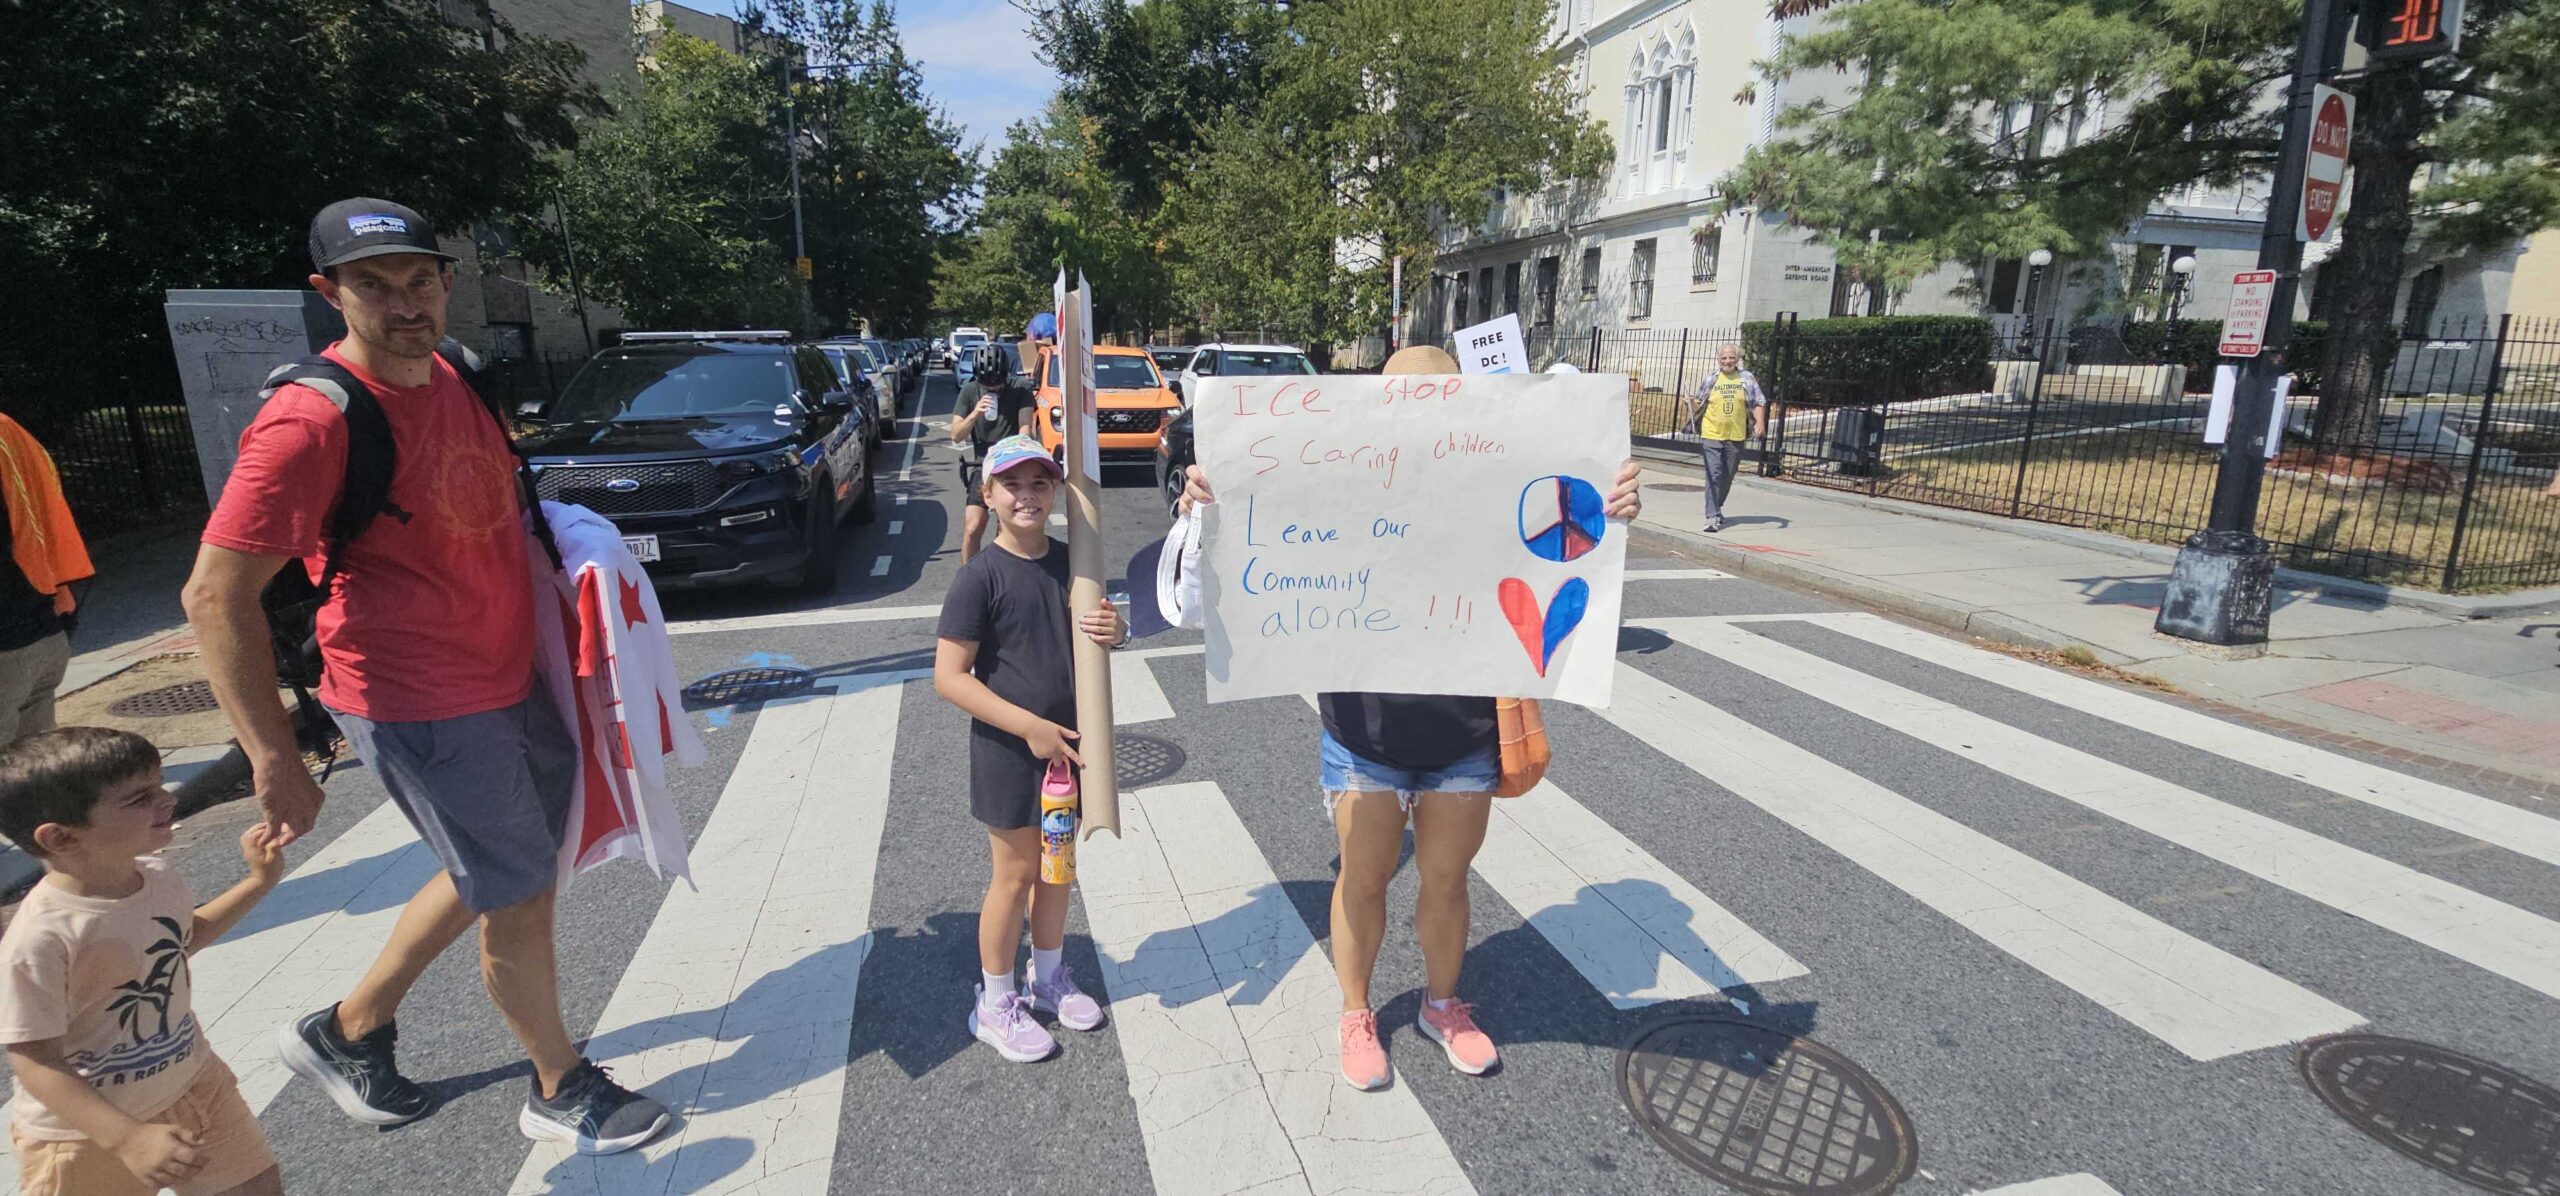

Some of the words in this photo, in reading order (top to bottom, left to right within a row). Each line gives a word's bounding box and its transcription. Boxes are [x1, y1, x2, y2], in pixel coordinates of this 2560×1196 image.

[2386, 0, 2439, 45] 30
[2316, 120, 2329, 143] DO
[2330, 127, 2346, 148] NOT
[2309, 189, 2333, 212] ENTER
[355, 224, 406, 236] patagonia
[2246, 286, 2256, 295] NO
[2234, 298, 2264, 307] STANDING
[2237, 309, 2263, 318] PARKING
[2232, 320, 2258, 329] ANYTIME
[1472, 332, 1504, 349] FREE
[1248, 494, 1339, 547] Leave
[1262, 599, 1401, 637] alone
[113, 1073, 125, 1085] A
[134, 1060, 169, 1082] RAD
